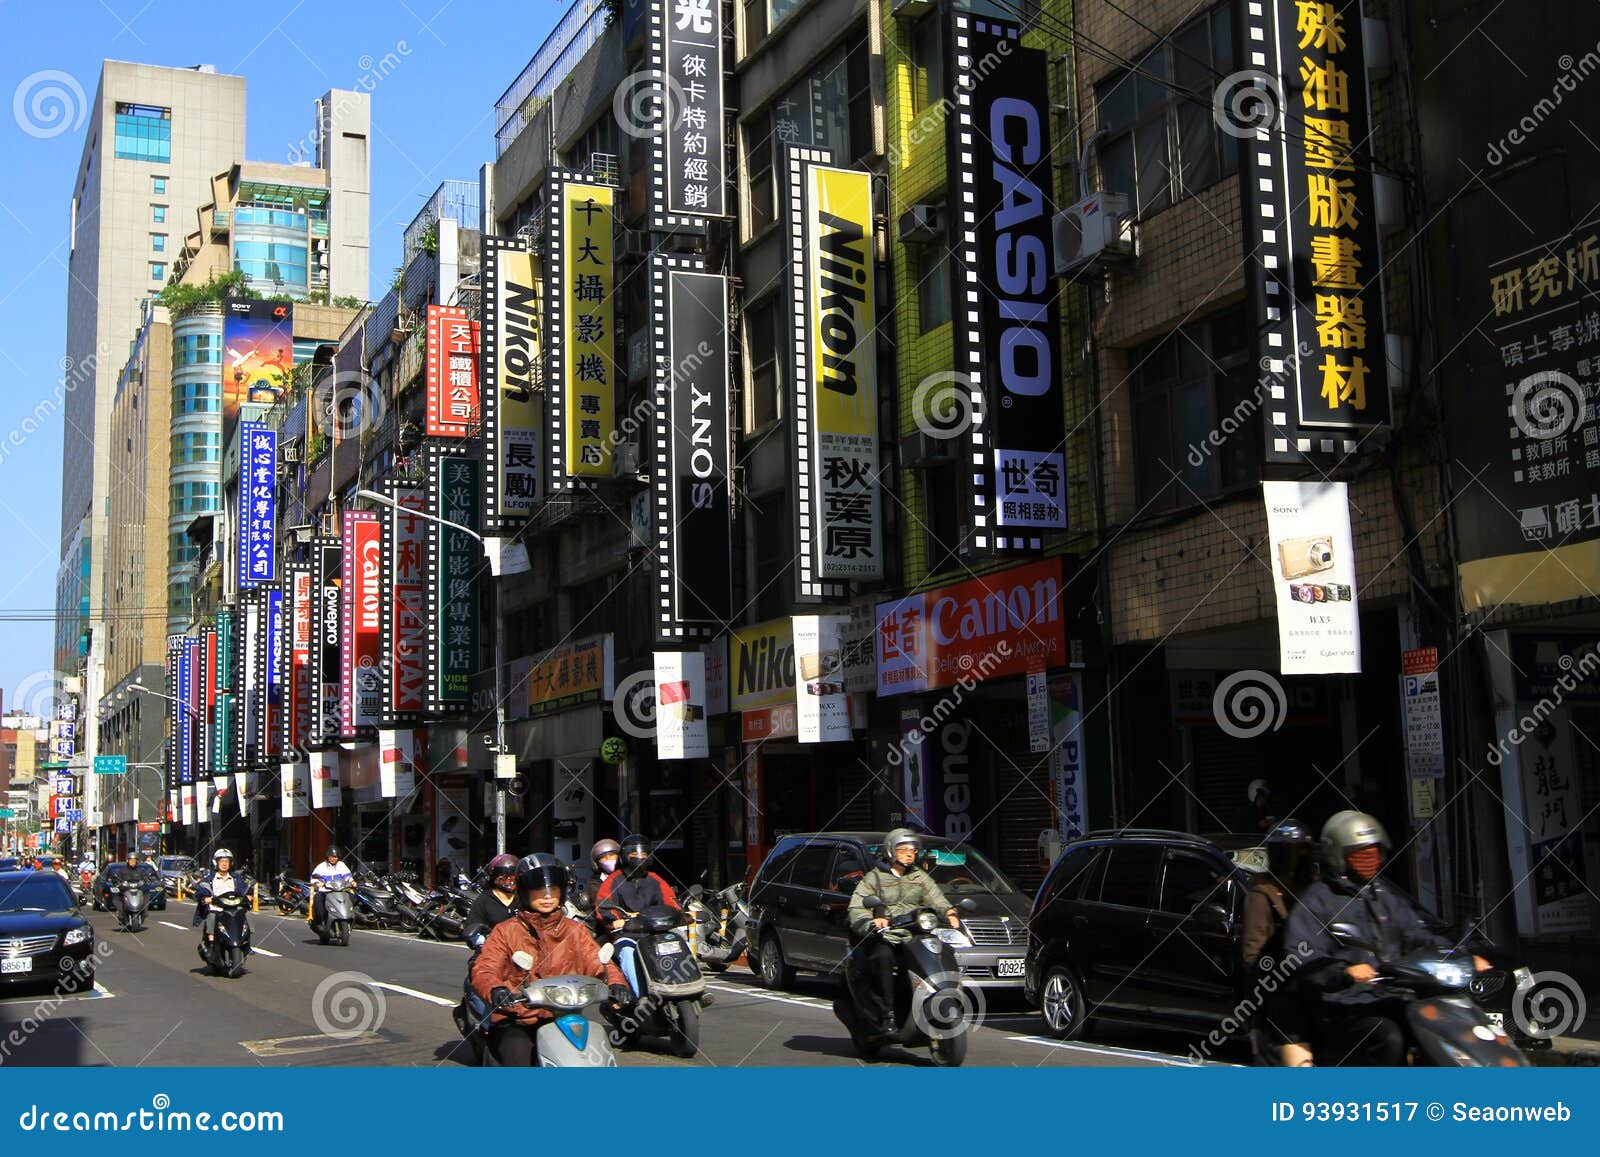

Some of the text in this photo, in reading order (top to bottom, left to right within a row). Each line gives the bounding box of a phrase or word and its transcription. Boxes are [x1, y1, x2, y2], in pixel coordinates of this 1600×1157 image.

[682, 54, 707, 208] 徠卡特約經銷
[989, 97, 1052, 398] CASIO
[1490, 235, 1600, 317] 研究所
[504, 280, 539, 403] Nikon
[574, 198, 607, 466] 千大攝影機專賣店
[818, 209, 867, 397] Nikon
[449, 323, 472, 419] 天工鐵櫃公司
[690, 383, 713, 510] SONY
[1001, 458, 1060, 497] 世奇
[823, 456, 875, 559] 秋葉原
[1003, 502, 1059, 521] 照相器材
[1272, 506, 1300, 514] SONY
[362, 539, 379, 628] Canon
[930, 577, 1059, 647] Canon
[399, 590, 423, 705] PENTAX
[737, 636, 796, 695] Niko
[841, 633, 874, 669] 葉原
[472, 686, 498, 713] SON
[771, 708, 797, 732] SIG
